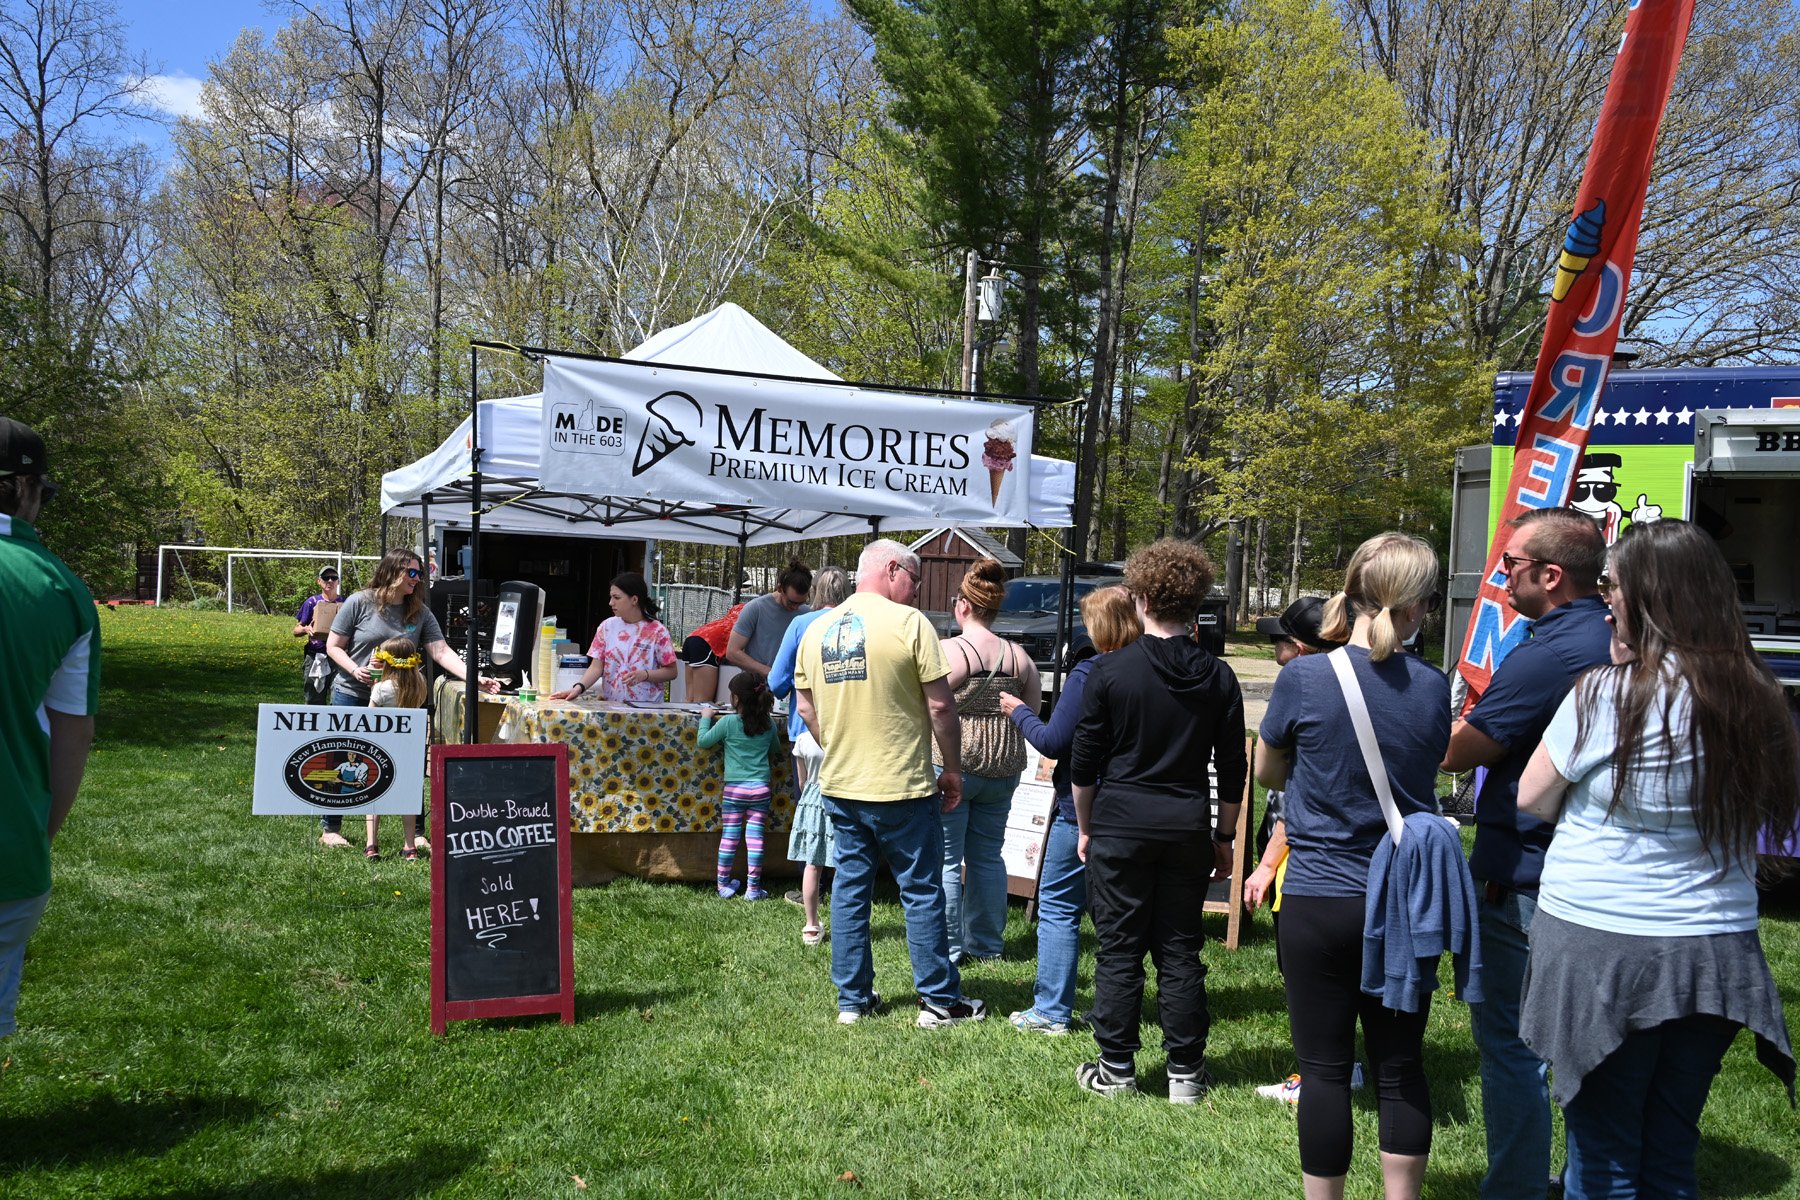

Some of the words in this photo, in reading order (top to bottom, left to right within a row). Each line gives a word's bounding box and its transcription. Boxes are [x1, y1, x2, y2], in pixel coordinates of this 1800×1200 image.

[554, 431, 568, 443] IN
[571, 432, 596, 446] THE
[599, 435, 623, 448] 603
[713, 403, 970, 470] MEMORIES
[708, 451, 828, 486] PREMIUM
[838, 463, 876, 489] ICE
[885, 467, 968, 497] CREAM
[273, 711, 321, 732] NH
[327, 713, 412, 734] MADE
[289, 749, 310, 768] New
[311, 739, 366, 752] Hampshire
[367, 745, 388, 769] Made
[309, 793, 369, 805] WWW.NHMADE.COM
[450, 799, 551, 822] Double-Brewed
[446, 829, 495, 855] ICED
[495, 823, 556, 849] COFFEE
[480, 873, 514, 895] Sold
[465, 898, 540, 930] HERE!
